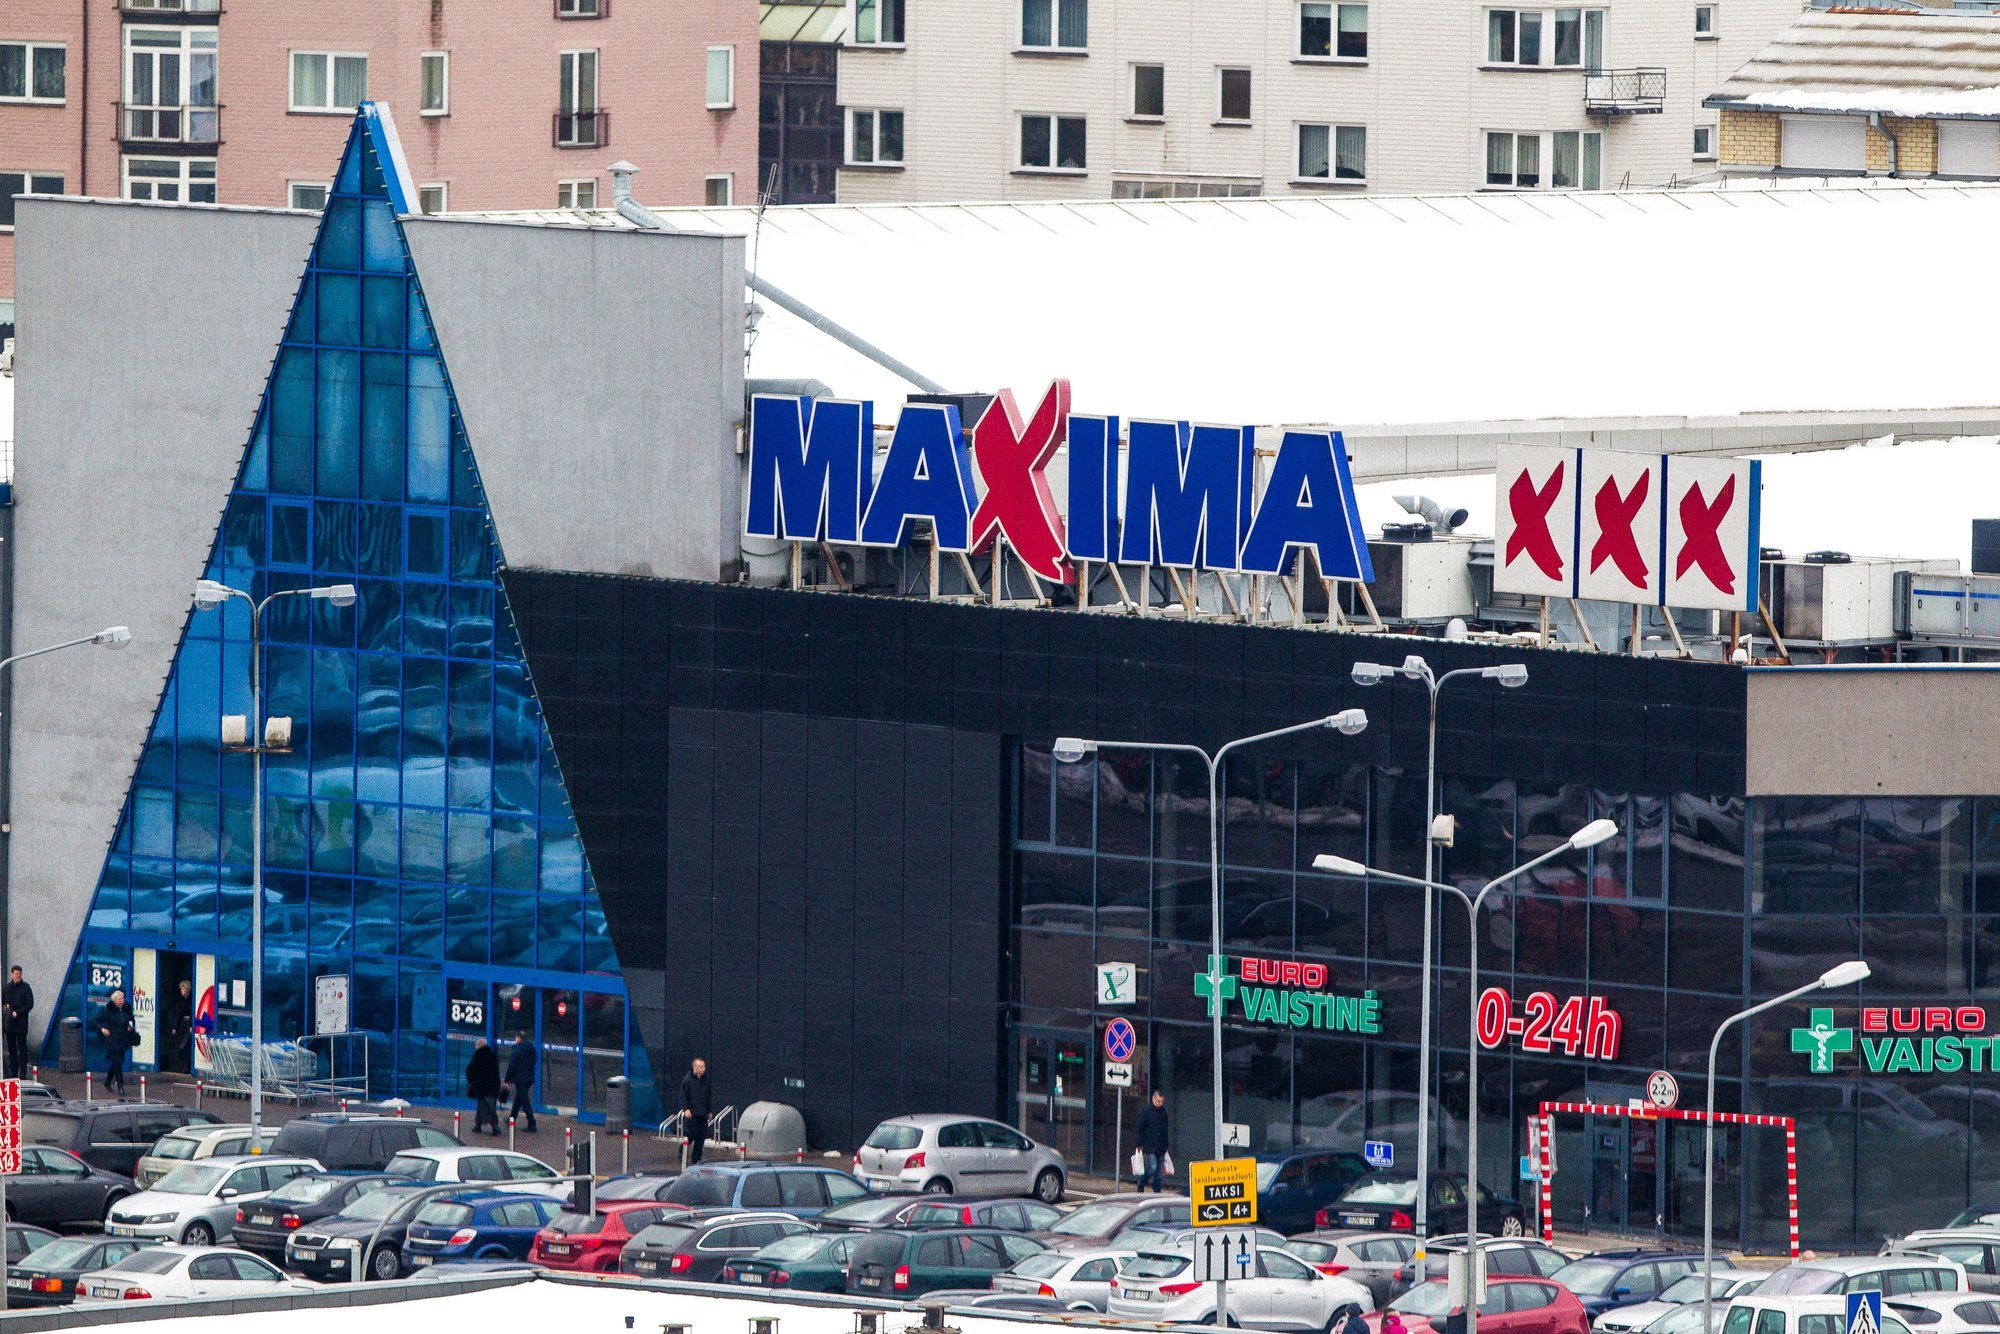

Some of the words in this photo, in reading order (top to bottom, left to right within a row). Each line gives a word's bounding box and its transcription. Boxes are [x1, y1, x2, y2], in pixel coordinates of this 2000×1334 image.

[744, 377, 1376, 584] MAXIMA
[92, 968, 122, 988] 8-23
[1241, 957, 1328, 988] EURO
[452, 1004, 483, 1025] 8-23
[1240, 986, 1383, 1034] VAISTINĖ
[1862, 1006, 1986, 1032] EURO
[1477, 987, 1622, 1060] 0-24h
[1216, 1165, 1238, 1174] juosta
[1209, 1185, 1240, 1198] TAKSI
[1233, 1204, 1248, 1216] 4+
